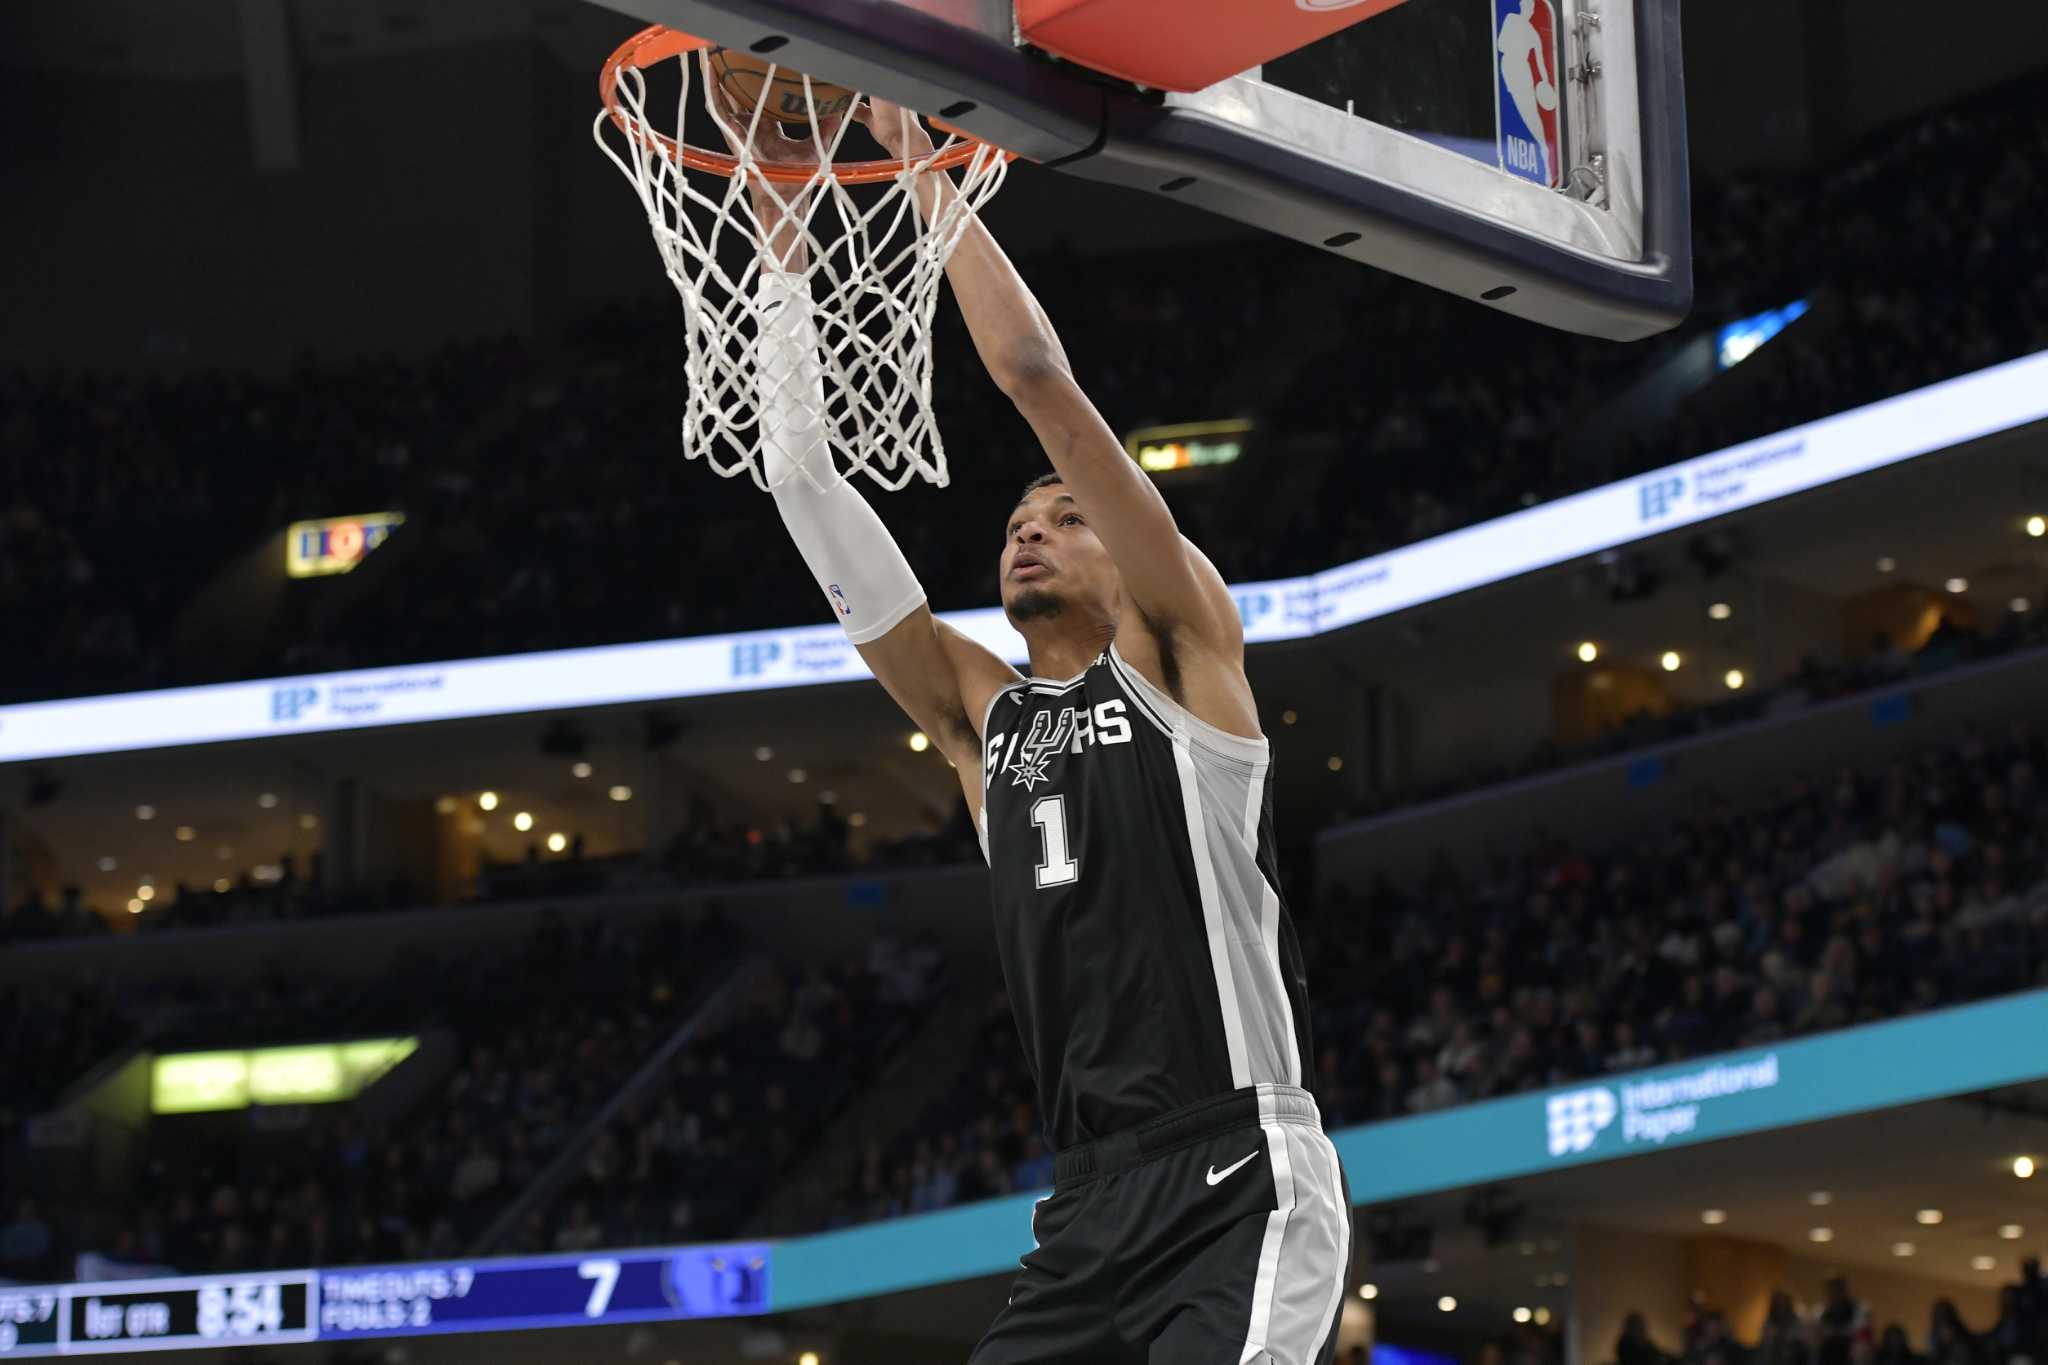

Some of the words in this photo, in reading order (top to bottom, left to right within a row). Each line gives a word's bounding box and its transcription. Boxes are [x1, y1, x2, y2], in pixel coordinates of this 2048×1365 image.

[1507, 134, 1538, 175] NBA
[1029, 793, 1079, 889] 1
[1620, 1052, 1779, 1110] International
[1620, 1104, 1698, 1144] Paper
[197, 1280, 282, 1339] 8:54
[579, 1259, 616, 1319] 7
